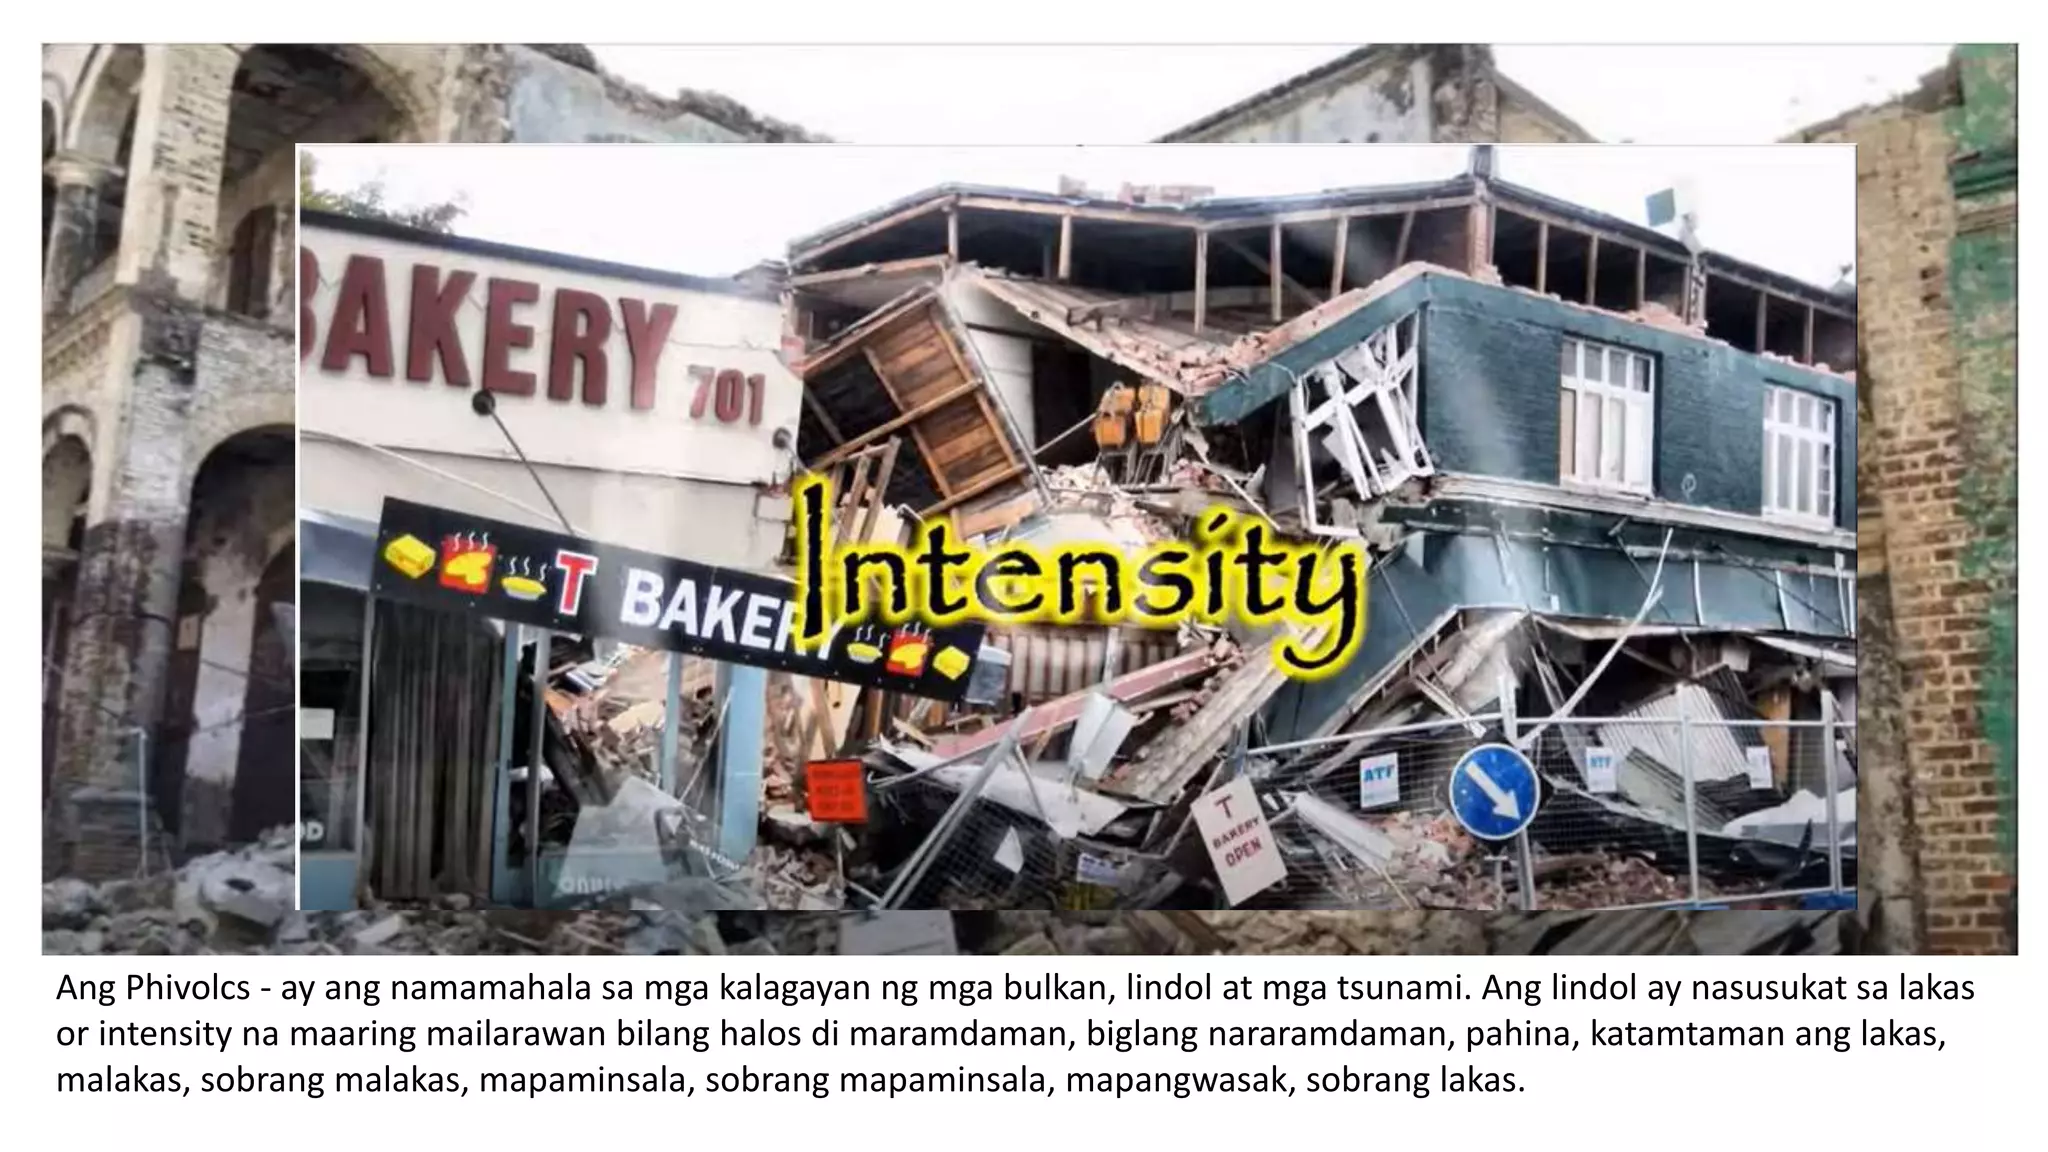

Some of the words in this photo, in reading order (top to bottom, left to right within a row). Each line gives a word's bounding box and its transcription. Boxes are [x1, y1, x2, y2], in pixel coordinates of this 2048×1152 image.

[687, 364, 766, 426] 701
[555, 549, 599, 616] T
[1213, 793, 1233, 819] T
[1212, 816, 1259, 850] BAKERY
[1225, 837, 1263, 868] OPEN
